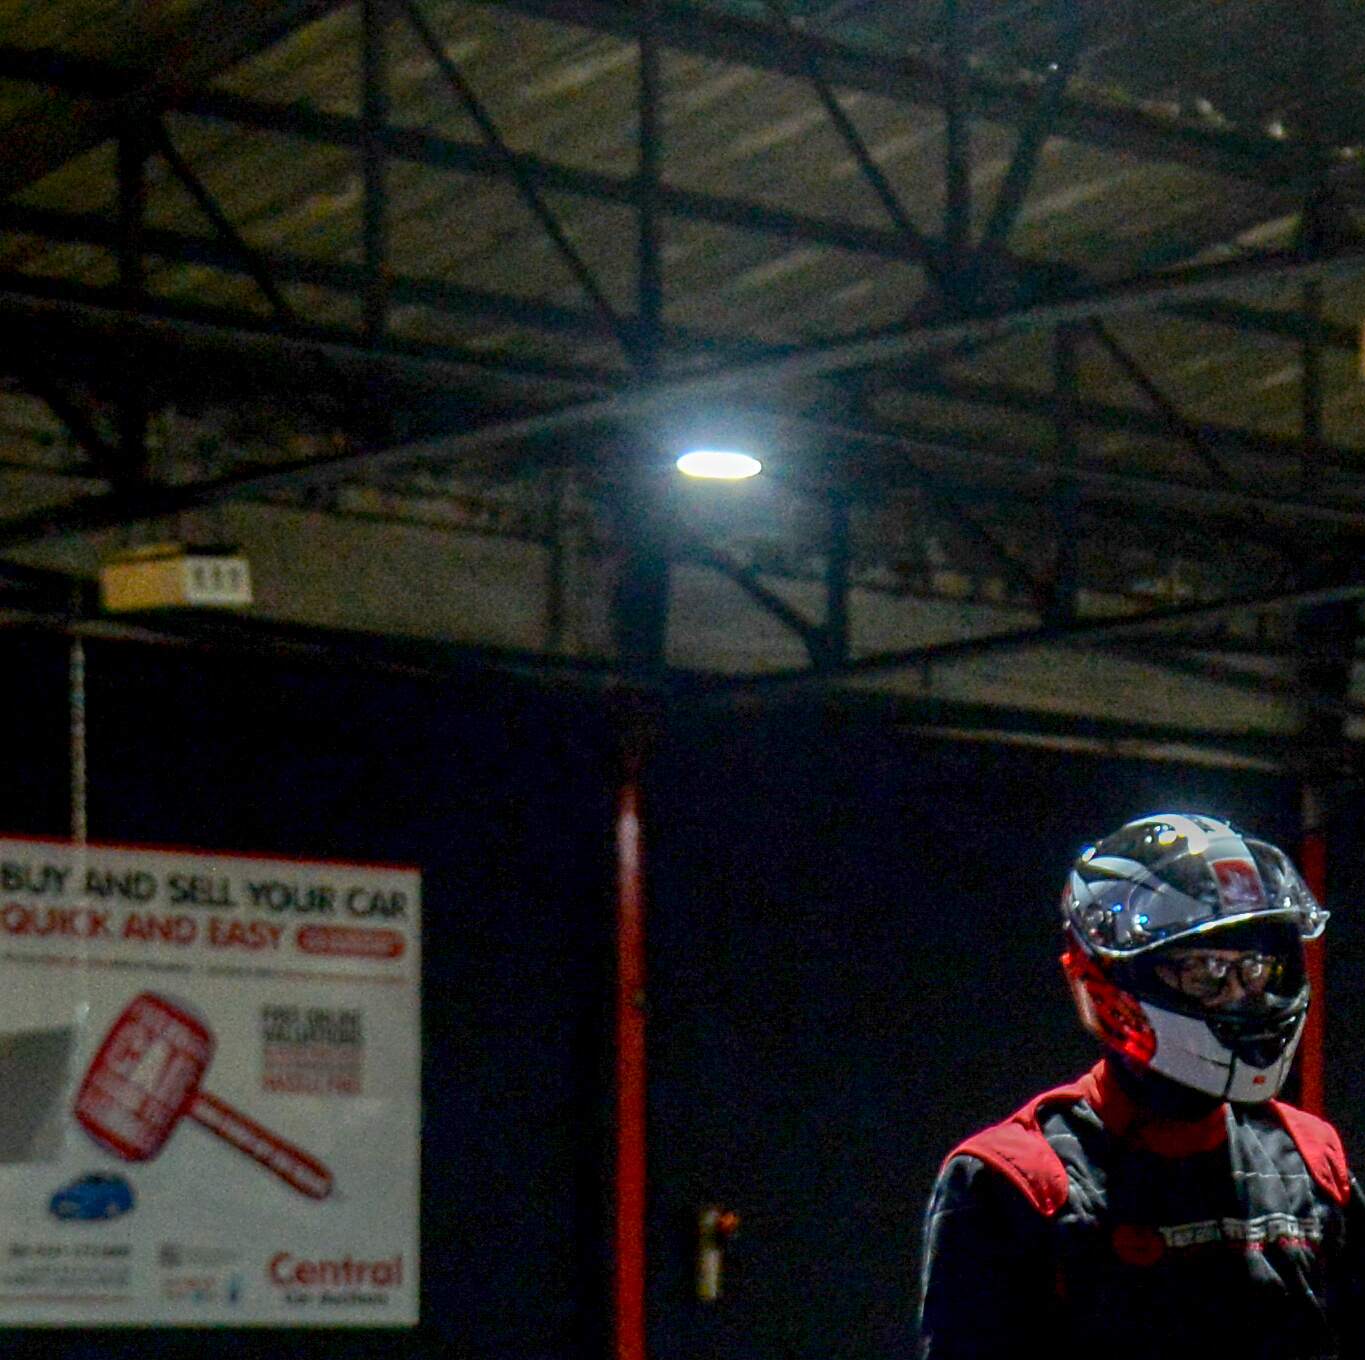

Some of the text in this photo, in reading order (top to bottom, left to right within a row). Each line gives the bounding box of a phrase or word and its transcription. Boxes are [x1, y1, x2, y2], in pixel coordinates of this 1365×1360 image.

[1, 864, 407, 917] BUY AND SELL YOUR CAR
[1, 903, 108, 938] QUICK
[122, 911, 197, 944] AND
[208, 915, 285, 950] EASY
[268, 1251, 403, 1286] Central
